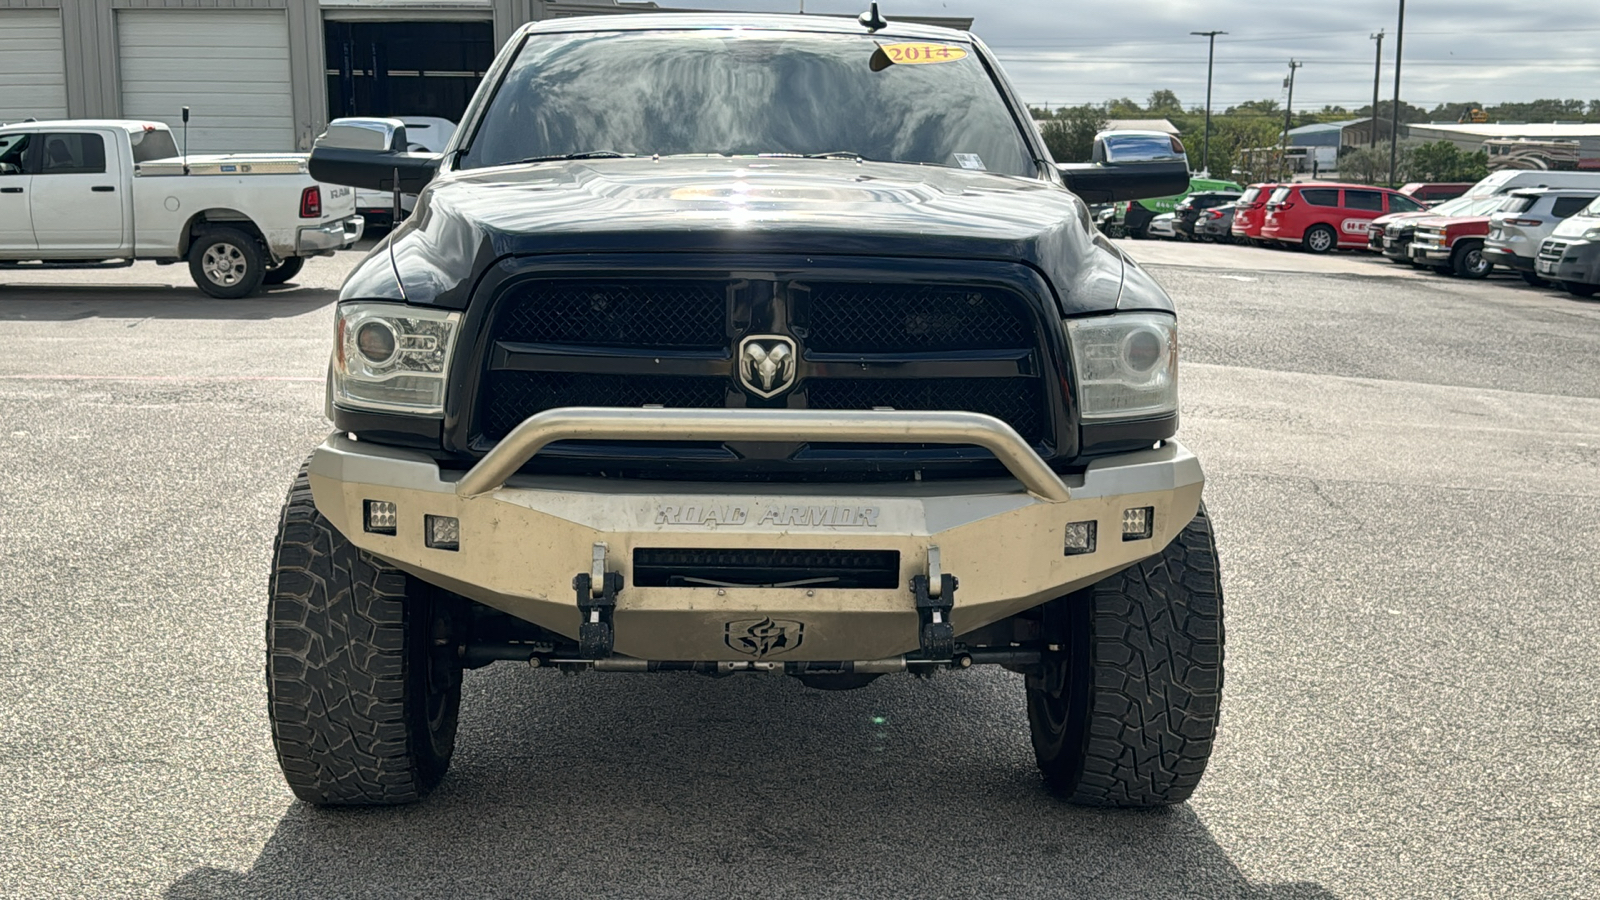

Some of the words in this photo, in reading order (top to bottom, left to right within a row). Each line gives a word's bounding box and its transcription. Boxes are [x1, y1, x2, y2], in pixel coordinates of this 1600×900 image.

[889, 46, 951, 61] 2014
[330, 187, 350, 199] RAM
[655, 505, 748, 526] ROAD
[758, 505, 880, 527] ARMOR
